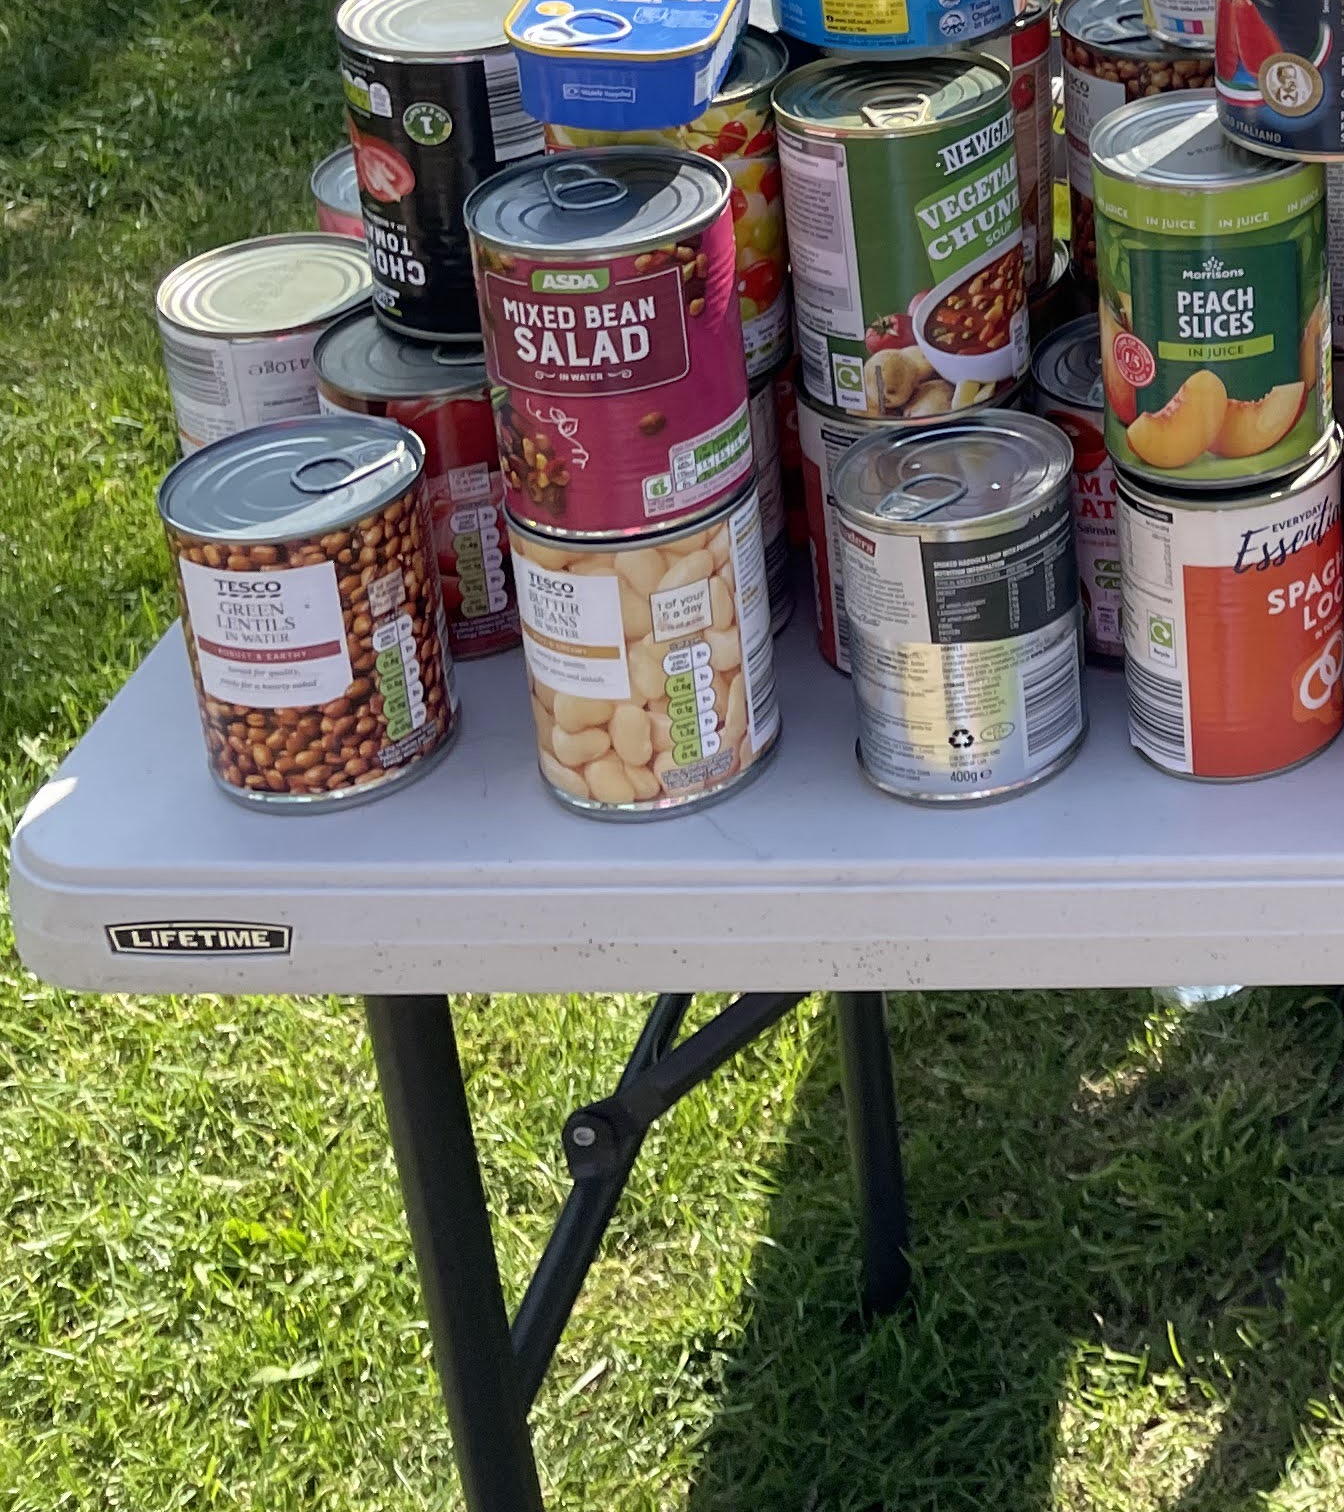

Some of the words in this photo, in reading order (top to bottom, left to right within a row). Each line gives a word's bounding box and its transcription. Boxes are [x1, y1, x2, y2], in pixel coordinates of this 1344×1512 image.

[1146, 216, 1158, 227] IN
[1161, 217, 1196, 230] JUICE
[1219, 217, 1231, 228] IN
[1234, 211, 1270, 225] JUICE
[986, 220, 1012, 246] SOUP
[542, 271, 598, 291] ASDA
[1182, 266, 1244, 281] Morrisons
[1177, 286, 1254, 314] PEACH
[503, 297, 577, 326] MIXED
[584, 296, 657, 325] BEAN
[1178, 311, 1254, 339] SLICES
[515, 326, 651, 367] SALAD
[1188, 346, 1202, 358] IN
[1204, 344, 1245, 357] JUICE
[560, 372, 569, 381] IN
[571, 371, 603, 382] WATER
[1272, 502, 1322, 533] EVERYDAY
[216, 579, 281, 593] TESCO
[528, 571, 574, 592] TESCO
[220, 602, 285, 615] GREEN
[529, 590, 581, 616] BUTTER
[657, 602, 662, 611] 1
[665, 599, 677, 610] of
[680, 591, 705, 608] your
[534, 605, 577, 629] BEANS
[662, 611, 669, 621] 5
[684, 603, 702, 619] day
[216, 615, 296, 631] LENTILS
[544, 623, 579, 639] WATER
[226, 632, 235, 641] IN
[237, 633, 289, 643] WATER
[267, 650, 307, 658] EARTHY
[949, 769, 979, 785] 400g
[130, 929, 271, 949] LIFETIME
